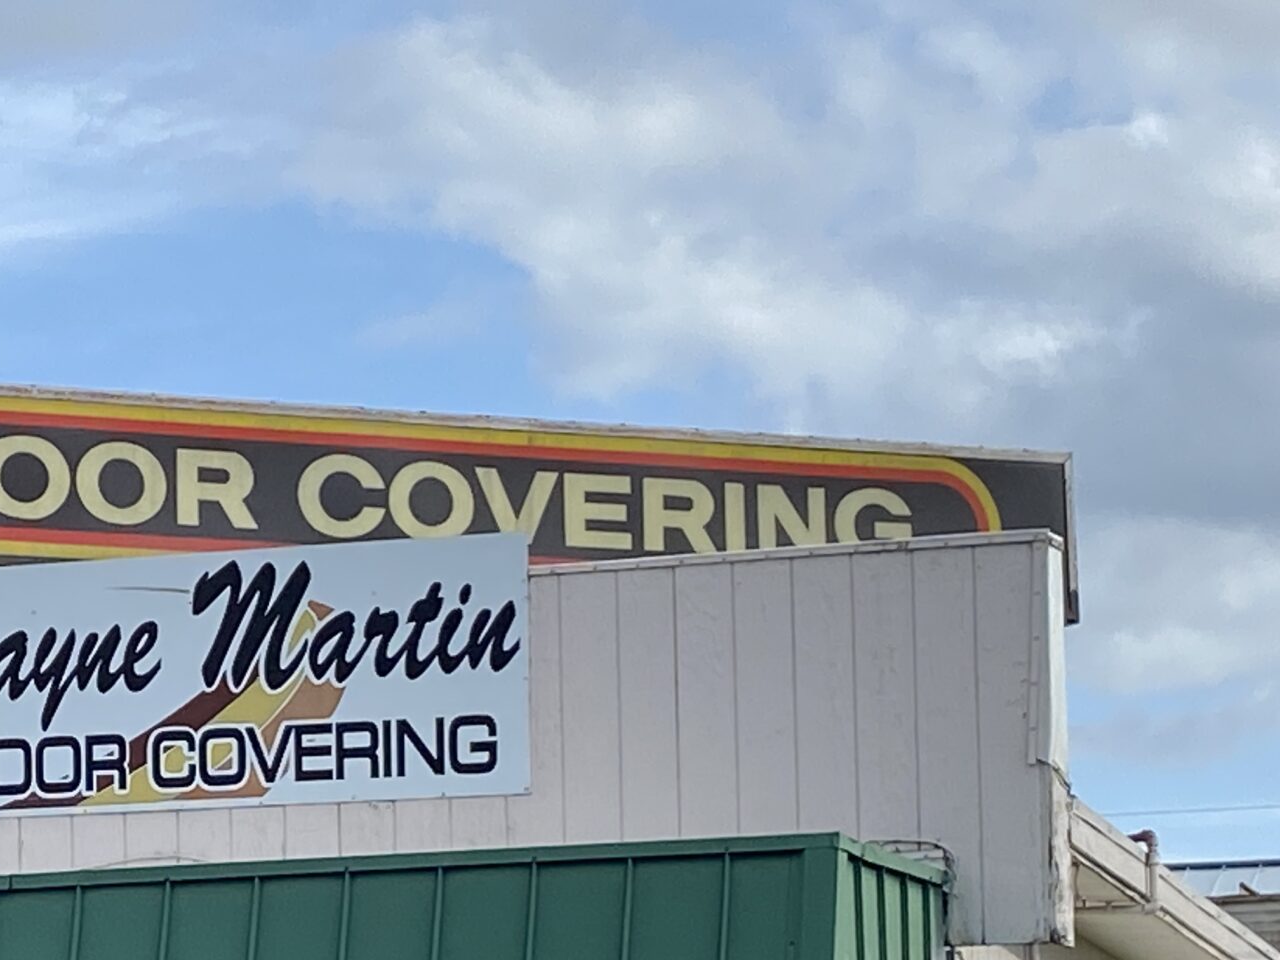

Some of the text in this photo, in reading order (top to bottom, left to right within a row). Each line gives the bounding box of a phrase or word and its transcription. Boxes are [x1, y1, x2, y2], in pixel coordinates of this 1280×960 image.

[297, 453, 914, 553] COVERING
[191, 559, 521, 692] Martin
[150, 714, 499, 789] COVERING
